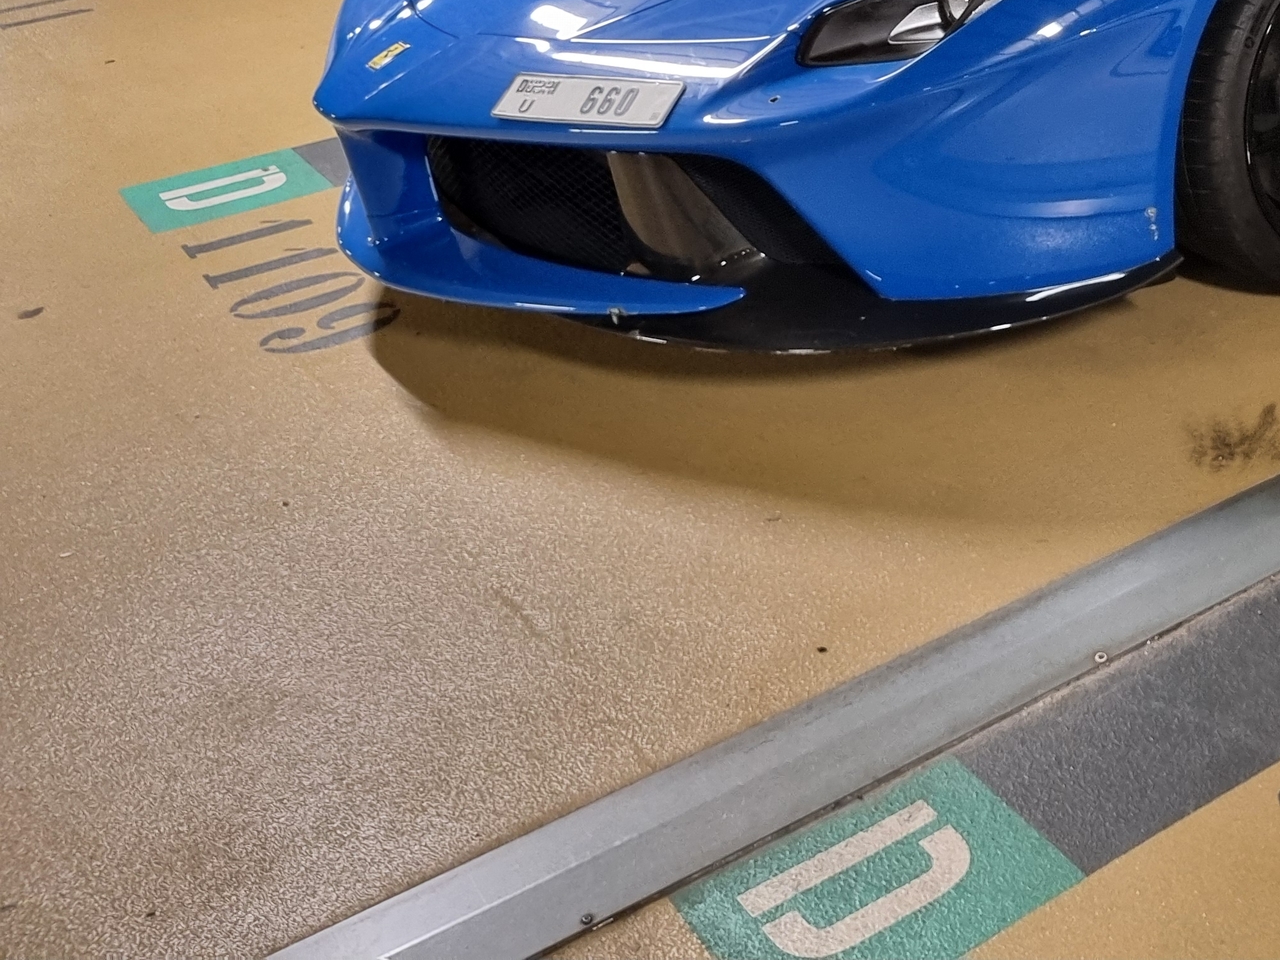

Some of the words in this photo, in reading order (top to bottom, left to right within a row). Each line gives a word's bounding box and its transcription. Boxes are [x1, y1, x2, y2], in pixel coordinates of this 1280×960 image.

[518, 98, 536, 113] U
[579, 86, 640, 117] 660
[159, 165, 287, 211] D
[181, 219, 401, 354] 1109
[737, 799, 971, 958] D
